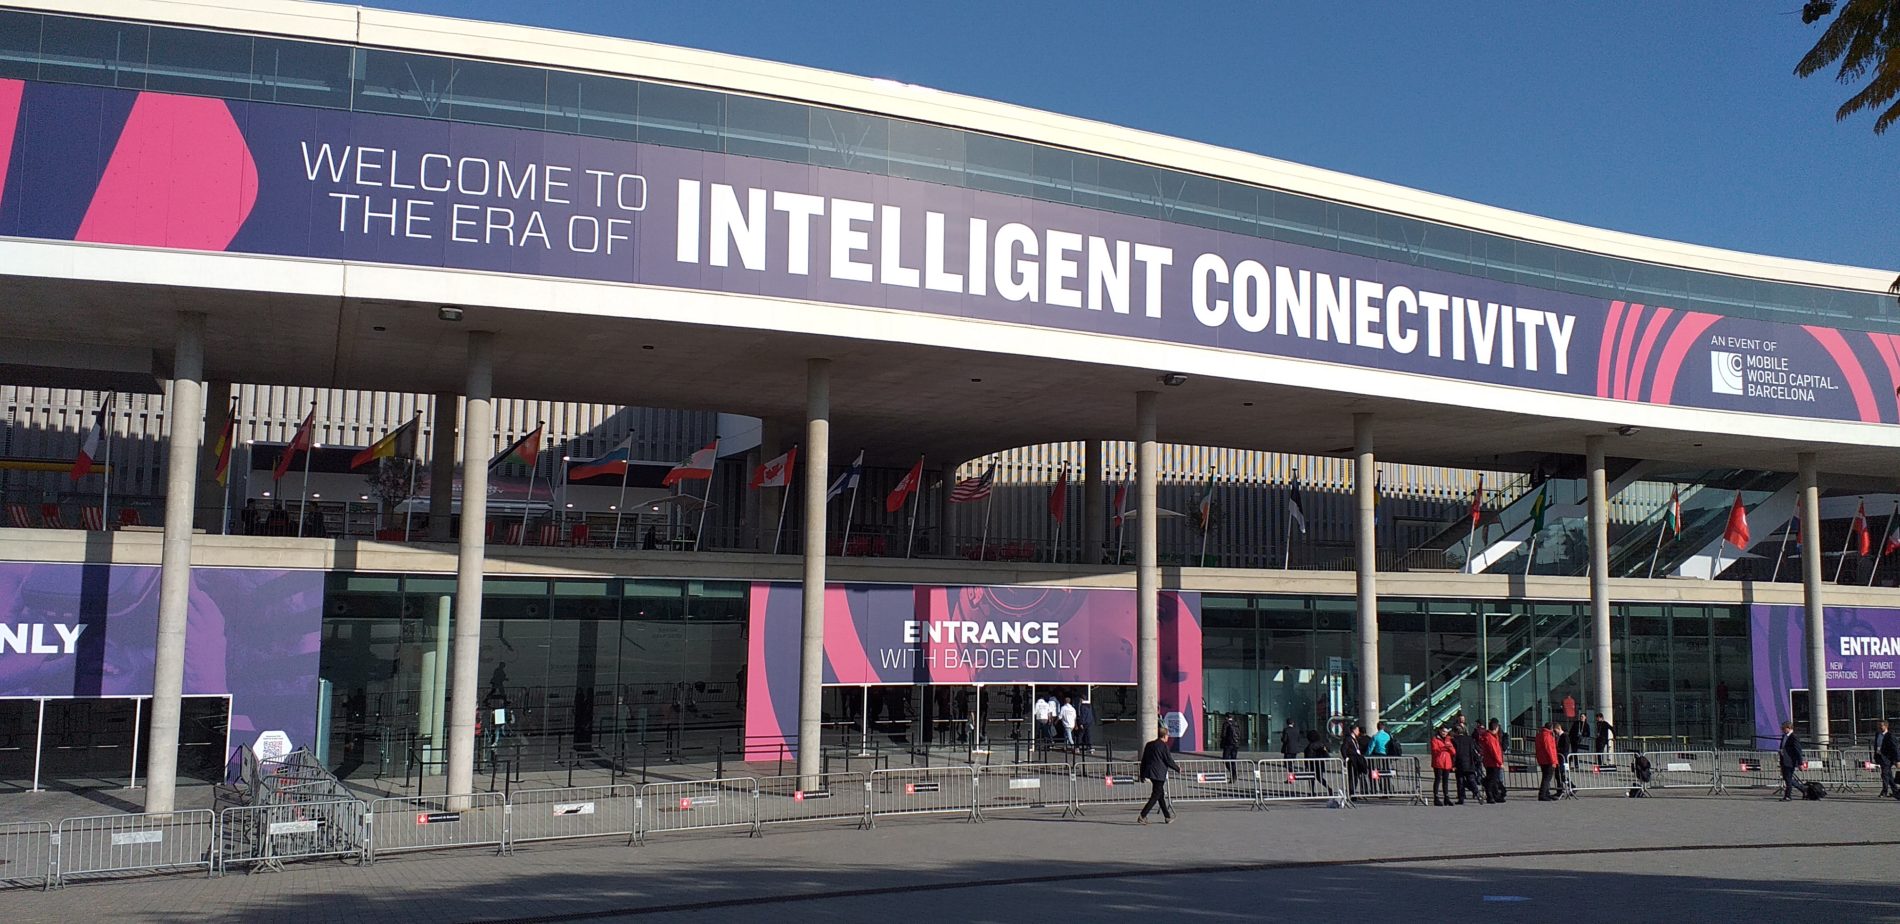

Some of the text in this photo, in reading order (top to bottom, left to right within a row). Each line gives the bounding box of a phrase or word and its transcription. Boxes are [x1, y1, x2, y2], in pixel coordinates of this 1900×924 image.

[301, 141, 648, 212] WELCOME TO
[328, 192, 633, 256] THE ERA OF
[676, 178, 1577, 376] INTELLIGENT CONNECTIVITY
[1710, 335, 1778, 352] AN EVENT OF
[1746, 354, 1789, 371] MOBILE
[1747, 369, 1787, 385] WORLD
[1748, 384, 1816, 402] BARCELONA
[903, 621, 1059, 644] ENTRANCE
[1840, 636, 1900, 656] ENTRAN
[880, 648, 1082, 668] WITH BADGE ONLY
[1830, 662, 1843, 670] NEW
[1869, 662, 1893, 670] PAYMENT
[1868, 671, 1896, 679] ENQUIRIES
